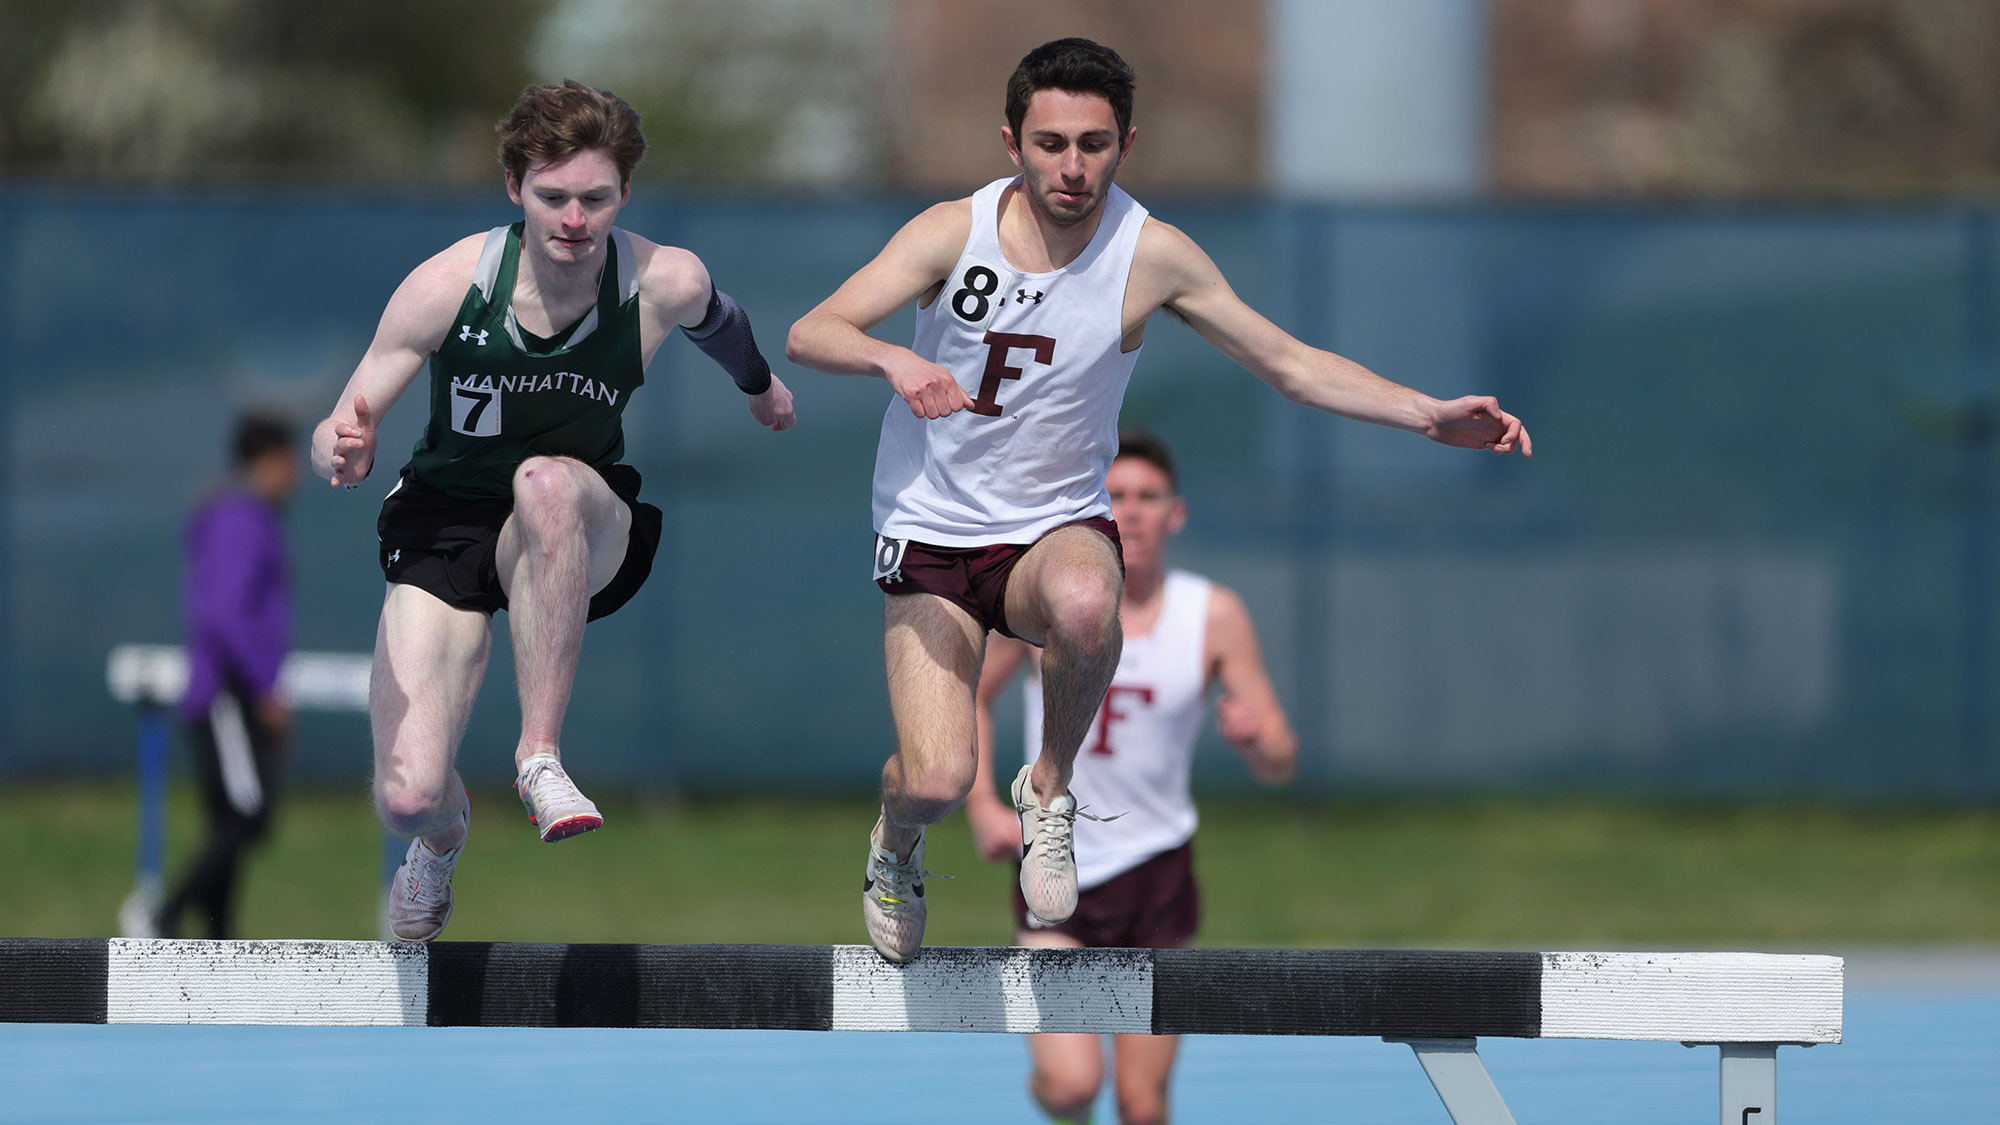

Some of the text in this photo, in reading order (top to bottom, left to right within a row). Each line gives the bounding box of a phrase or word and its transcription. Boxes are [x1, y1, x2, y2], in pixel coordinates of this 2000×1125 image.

[952, 265, 999, 322] 8
[966, 329, 1057, 417] F
[455, 387, 493, 433] 7
[1088, 684, 1156, 758] F
